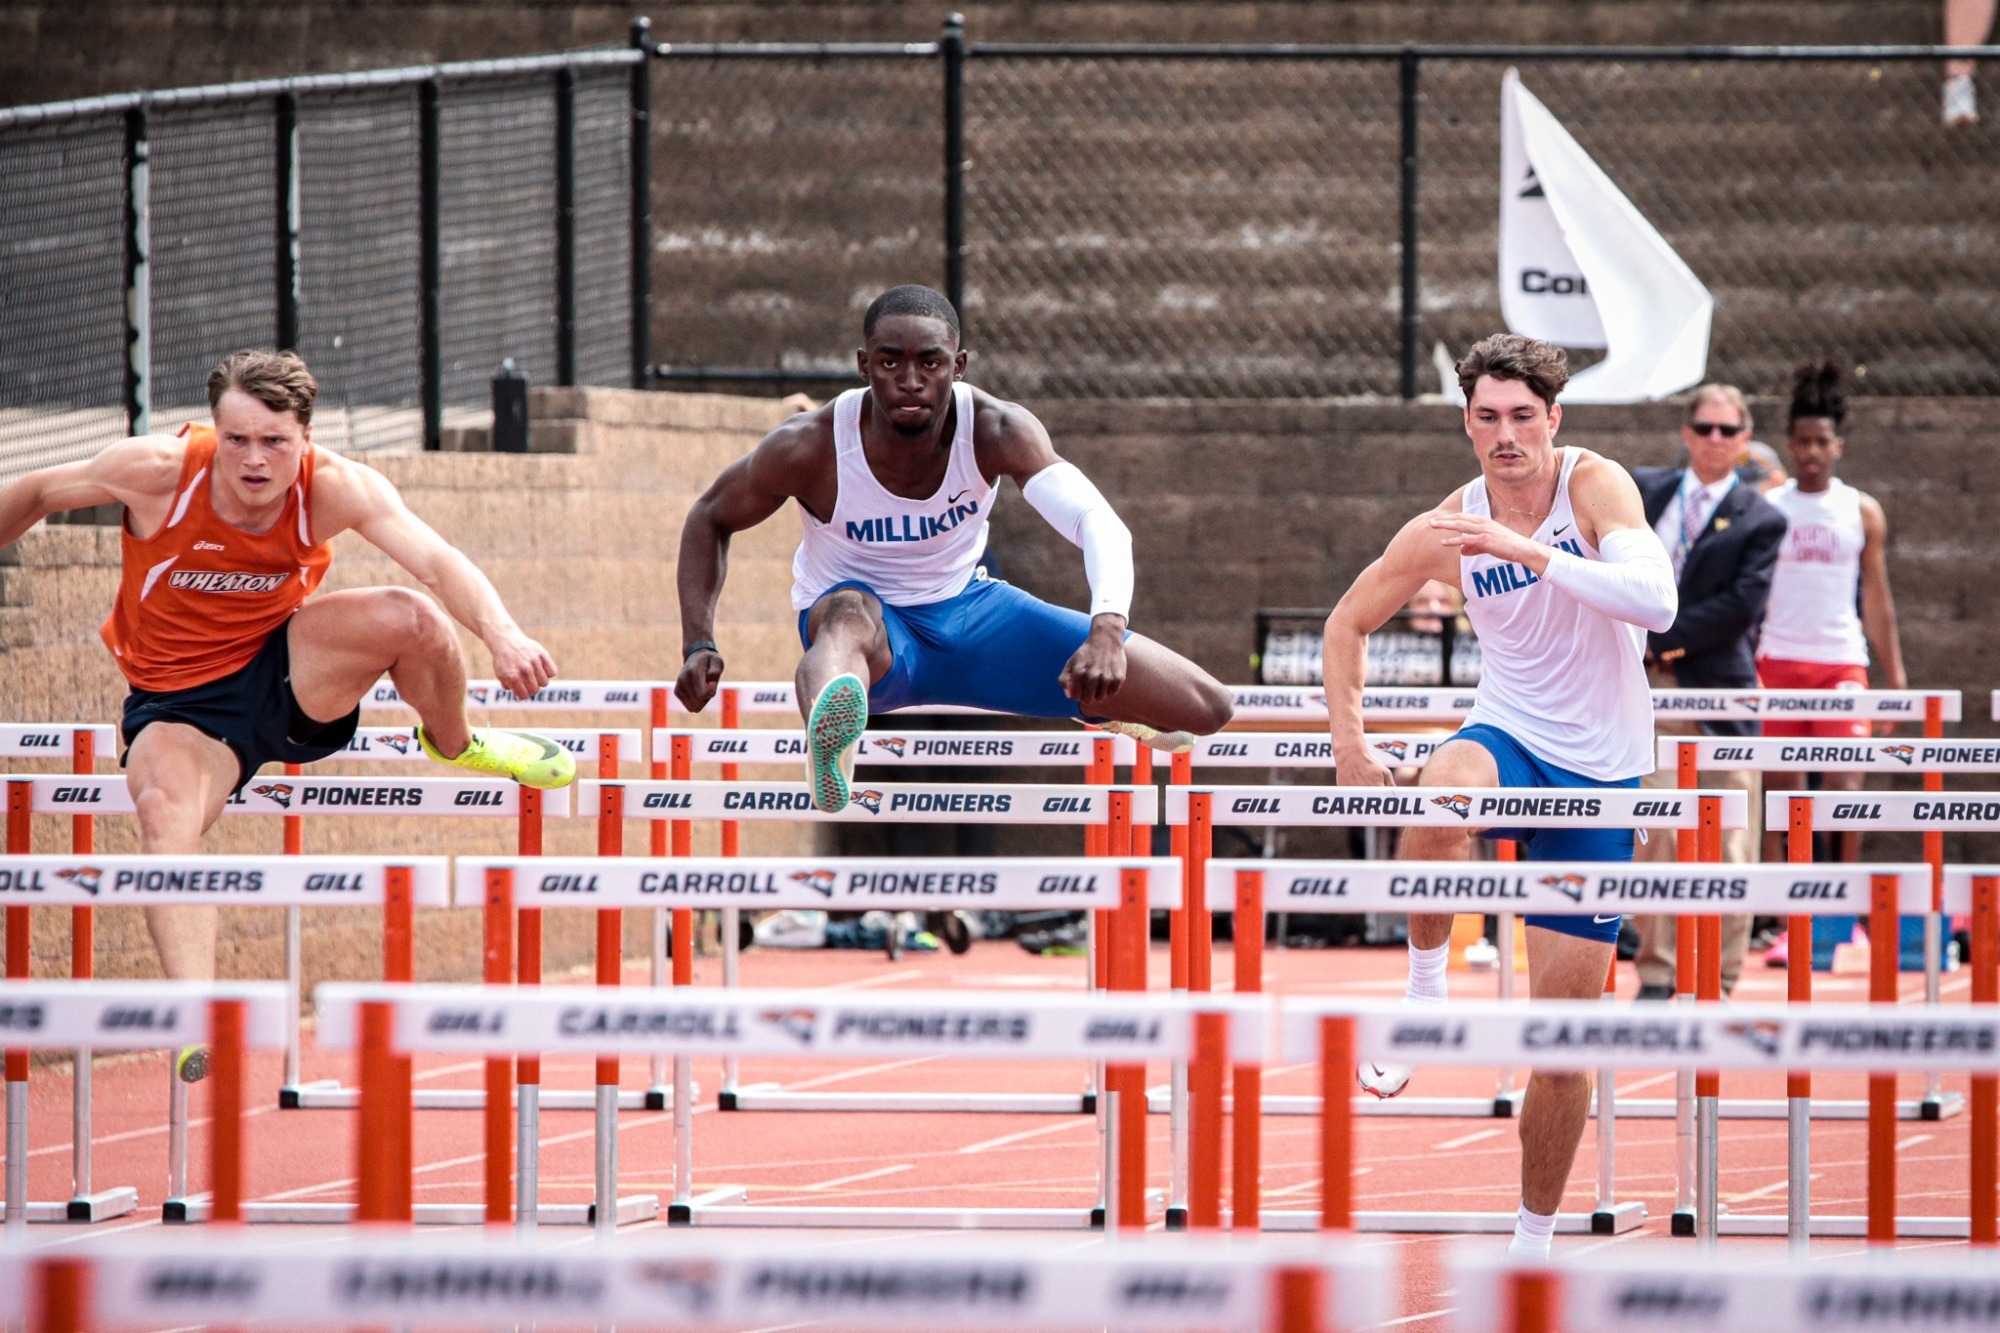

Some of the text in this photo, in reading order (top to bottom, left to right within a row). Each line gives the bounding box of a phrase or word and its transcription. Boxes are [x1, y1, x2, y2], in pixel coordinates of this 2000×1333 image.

[846, 500, 979, 542] MILLIKIN
[1472, 538, 1585, 598] MILLN
[169, 570, 289, 593] WHEATON
[604, 692, 639, 703] GILL
[1234, 693, 1304, 708] ARROLL
[1362, 695, 1430, 709] ONEERS
[1766, 697, 1855, 712] PIONEERS
[1877, 700, 1912, 712] GILL
[19, 734, 60, 747] GILL
[707, 740, 1080, 756] GILL PIONEERS GILL
[1207, 742, 1332, 758] GILL CARR
[1713, 747, 1754, 761] GILL
[1780, 746, 1876, 763] CARROLL
[51, 786, 503, 806] GILL PIONEERS GILL
[642, 791, 1092, 813] GILL CARRO PIONEERS GILL
[1231, 796, 1682, 817] GILL CARROLL PIONEERS GILL
[1832, 803, 1882, 820] GILL
[113, 870, 264, 892] PIONEERS
[304, 873, 363, 892] GILL
[539, 872, 1097, 895] GILL CARROLL PIONEERS GILL
[1289, 876, 1847, 900] GILL CARROLL PIONEERS GILL
